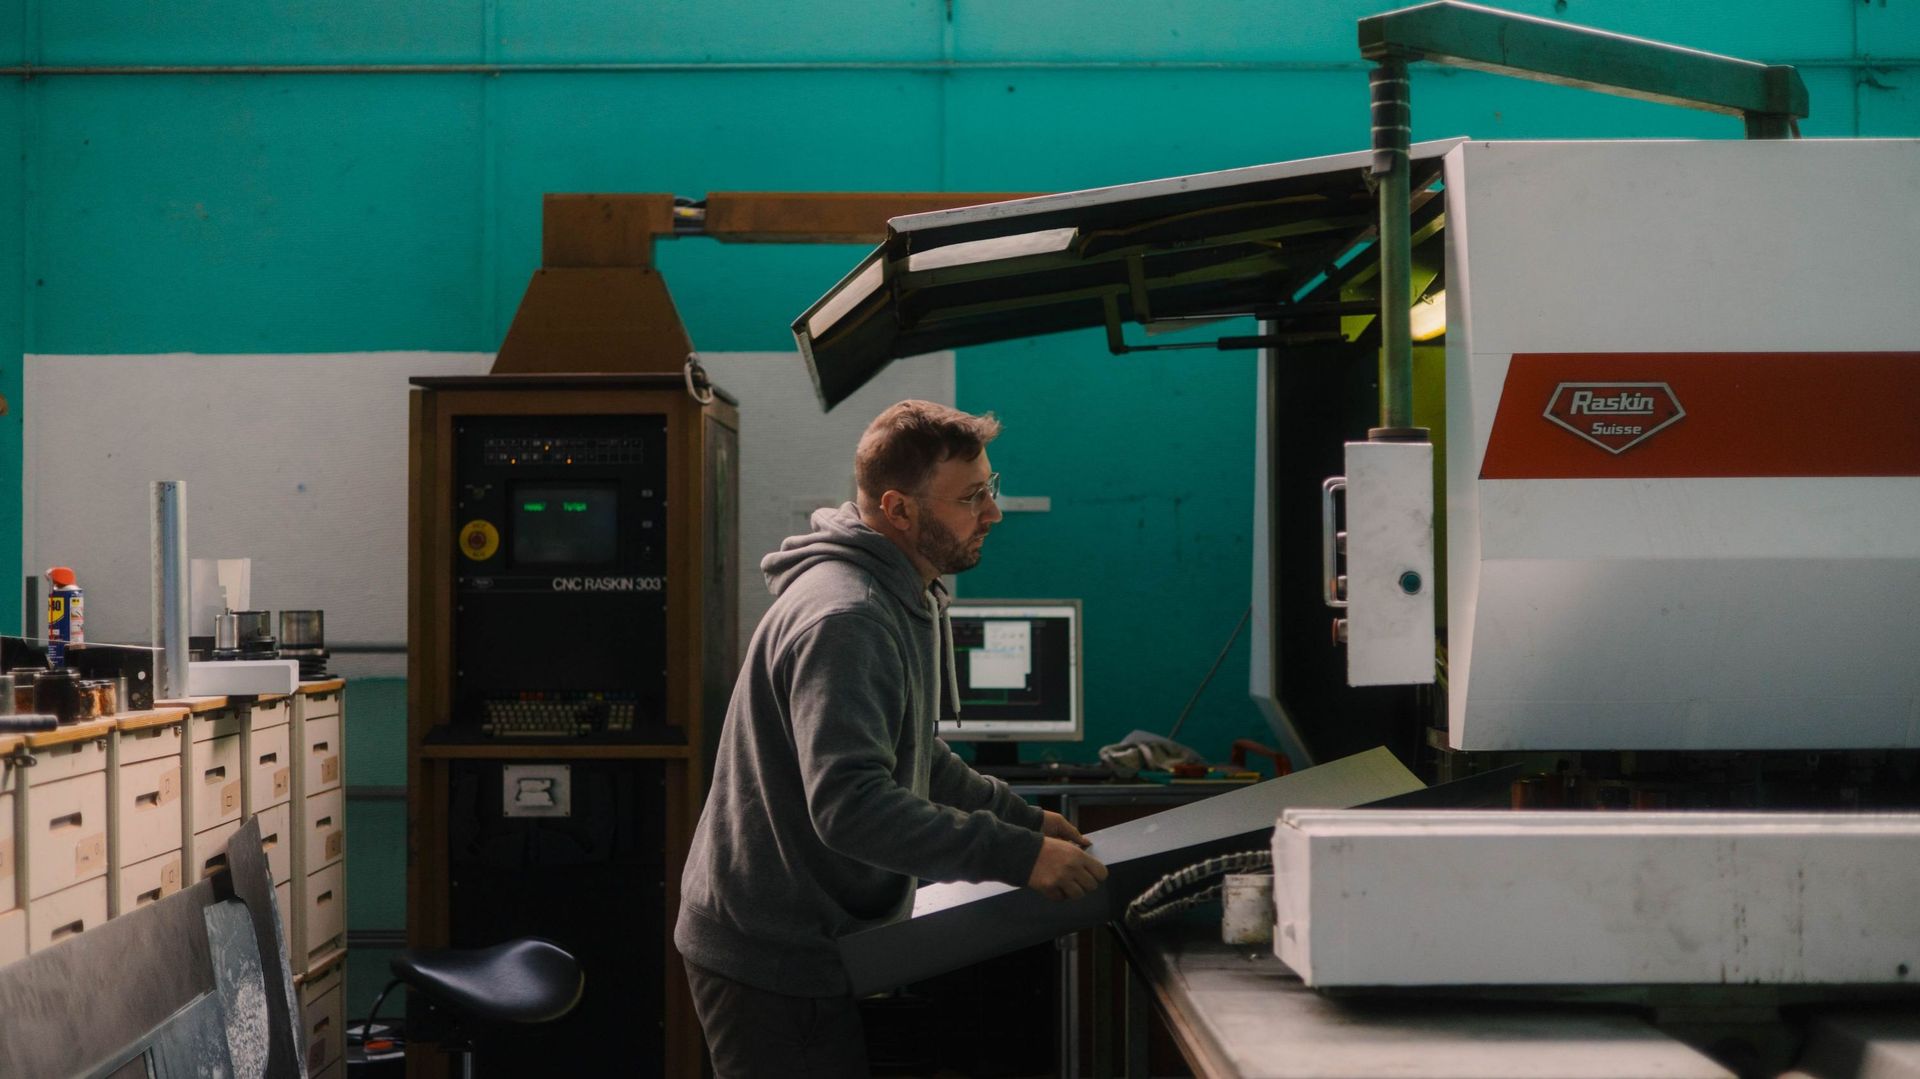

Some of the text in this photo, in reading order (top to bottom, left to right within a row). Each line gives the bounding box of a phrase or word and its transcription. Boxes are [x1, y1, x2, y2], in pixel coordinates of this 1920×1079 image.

[1570, 391, 1654, 415] Raskin
[1591, 422, 1642, 435] Suisse
[552, 577, 662, 591] CNC RASKIN 303
